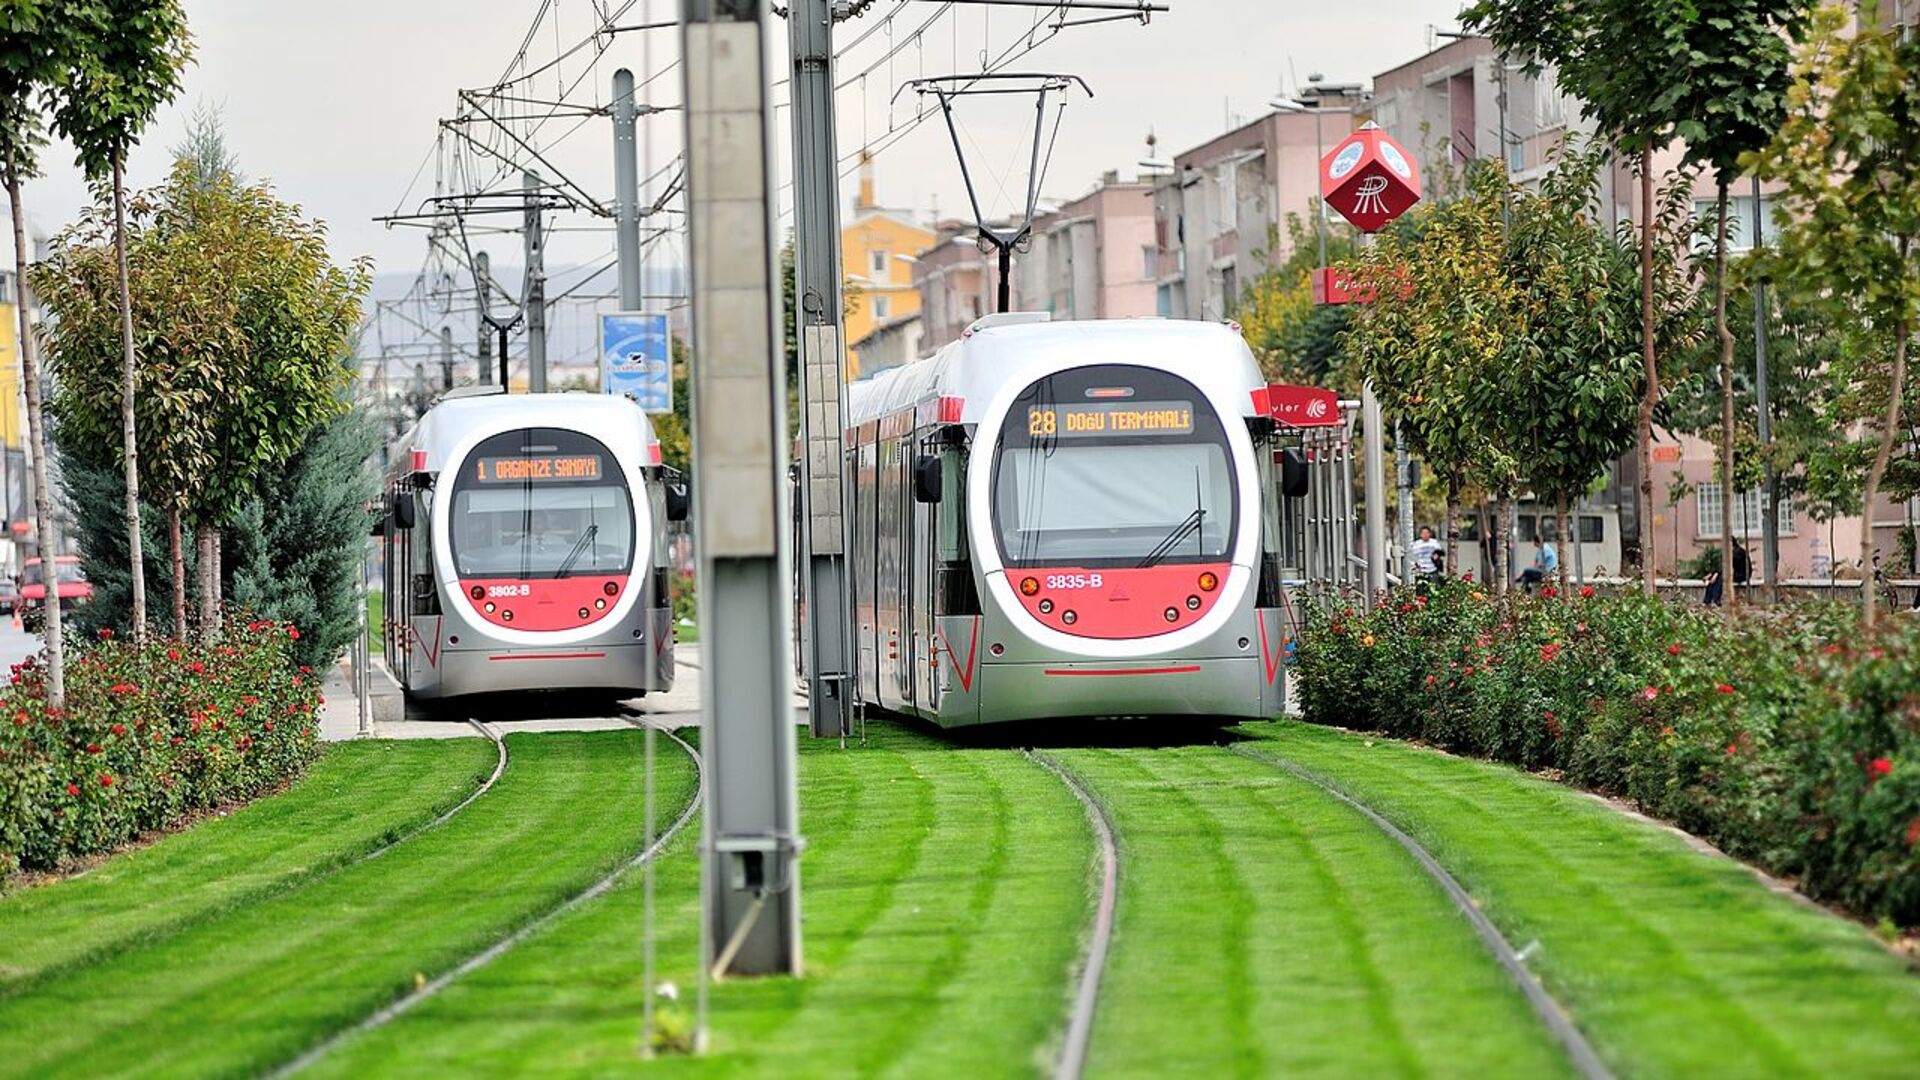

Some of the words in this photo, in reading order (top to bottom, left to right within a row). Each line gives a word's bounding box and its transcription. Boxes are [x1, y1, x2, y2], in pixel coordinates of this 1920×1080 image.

[1271, 403, 1300, 413] vler
[1029, 410, 1056, 436] 28
[478, 461, 487, 480] 1
[1046, 574, 1103, 588] 3835-B
[488, 585, 530, 597] 3802-B
